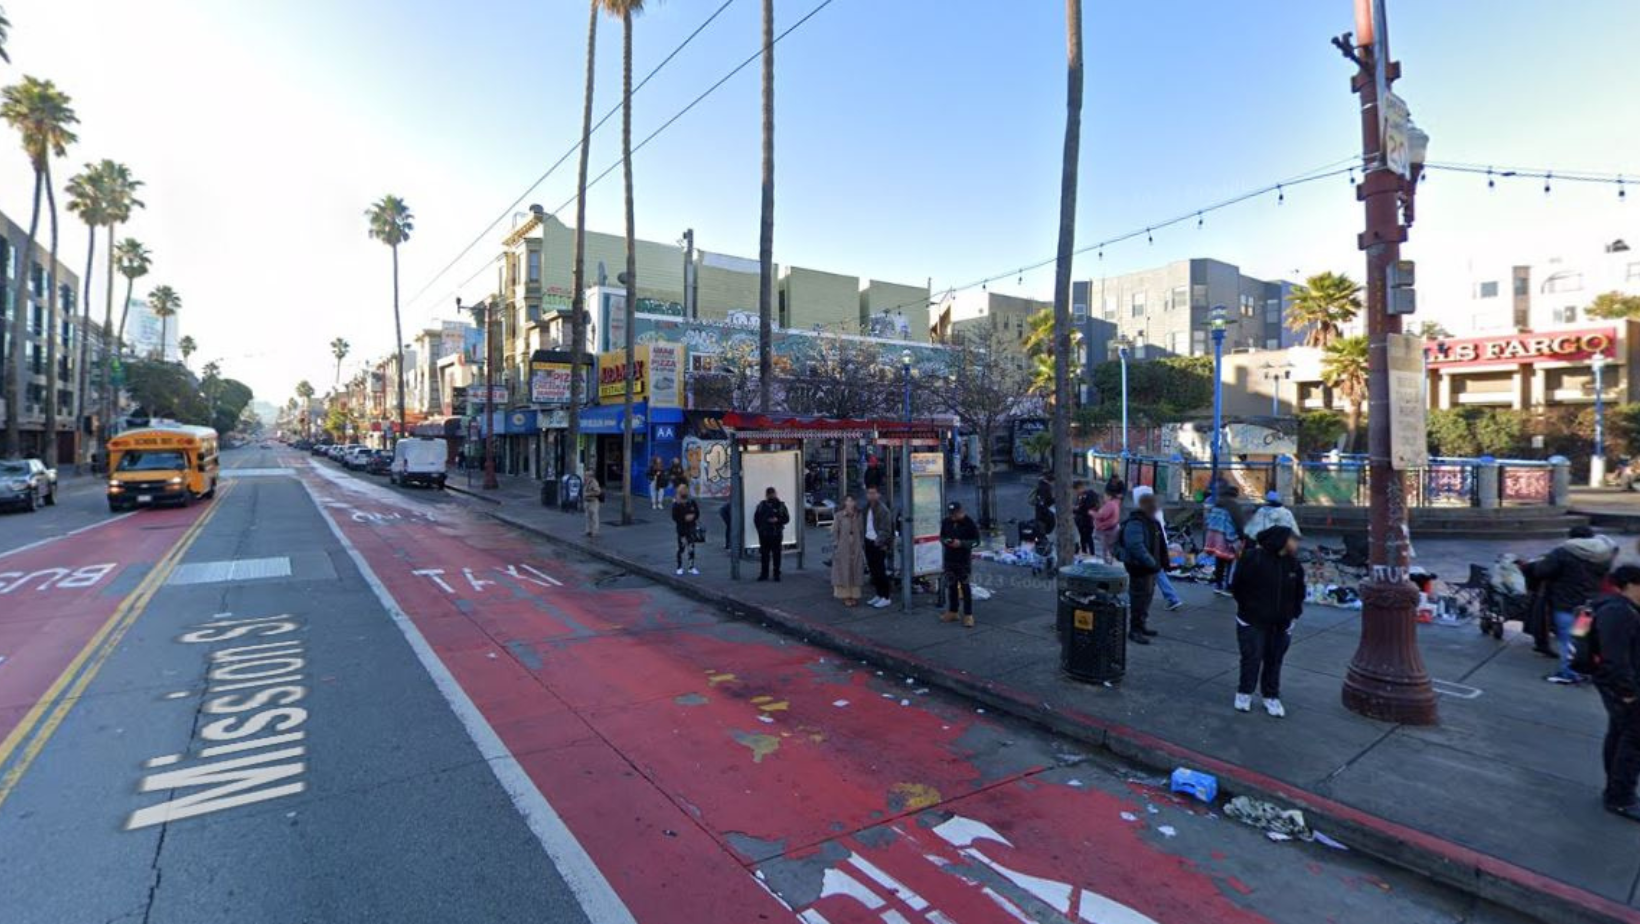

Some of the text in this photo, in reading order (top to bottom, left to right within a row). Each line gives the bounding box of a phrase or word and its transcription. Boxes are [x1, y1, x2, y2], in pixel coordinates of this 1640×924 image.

[1485, 333, 1609, 360] FARGO
[651, 359, 677, 368] PIZZA
[553, 372, 585, 383] PIZA
[657, 427, 674, 438] AA
